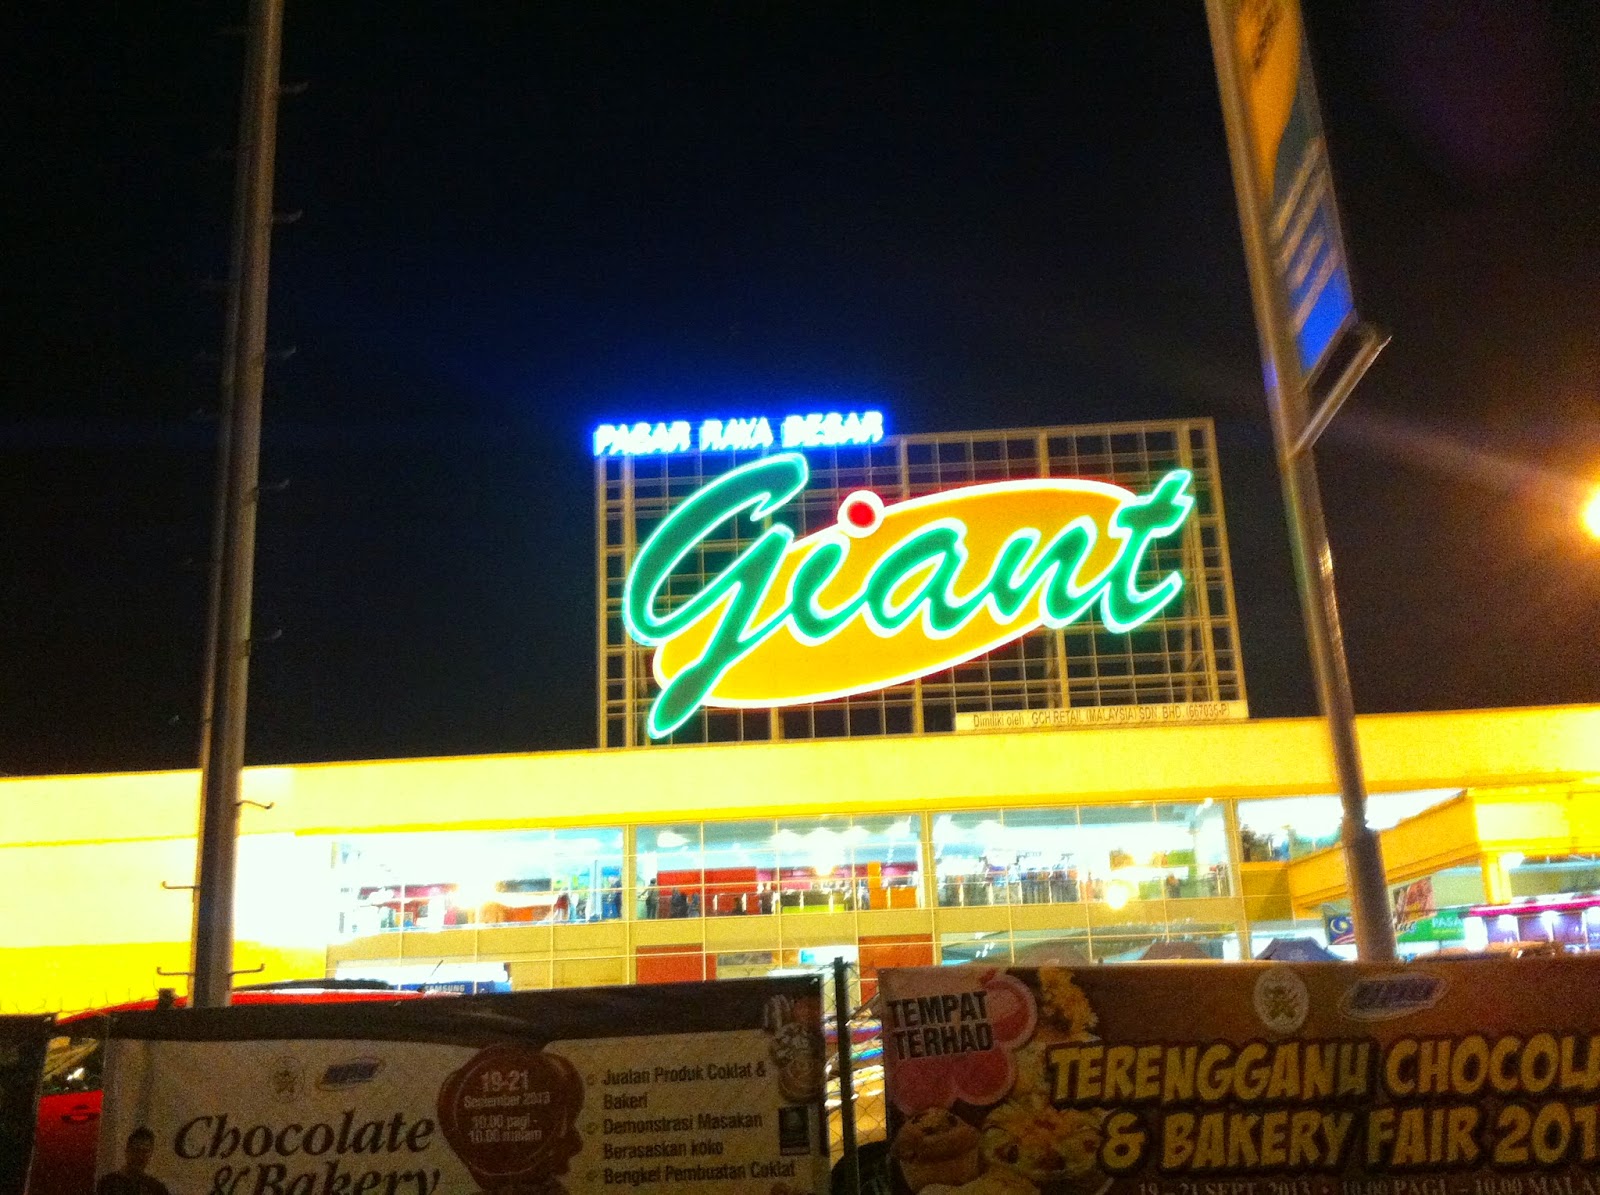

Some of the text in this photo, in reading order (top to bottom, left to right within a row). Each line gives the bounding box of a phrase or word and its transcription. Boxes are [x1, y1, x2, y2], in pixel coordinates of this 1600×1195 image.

[594, 411, 883, 455] PASAR RAYA BESAR
[973, 713, 1004, 727] Dimiliki
[1031, 711, 1051, 725] GCH
[1053, 709, 1085, 724] RETAIL
[1086, 707, 1137, 722] (MALAYSIA)
[424, 984, 466, 993] SAMSUNG
[886, 990, 988, 1028] TEMPAT
[891, 1022, 994, 1060] TERHAD
[480, 1069, 529, 1092] 19-21
[602, 1061, 767, 1086] Jualan Produk Coklat &
[1050, 1041, 1370, 1101] TERENGGANU
[463, 1093, 522, 1109] September
[603, 1093, 648, 1110] Bakeri
[173, 1108, 435, 1159] Chocolate
[602, 1112, 764, 1135] Demonstrasi Masakan
[1103, 1111, 1146, 1170] &
[1160, 1109, 1354, 1169] BAKERY
[1367, 1105, 1481, 1166] FAIR
[603, 1141, 688, 1160] Berasaskan
[253, 1159, 441, 1195] Bakery
[603, 1166, 661, 1187] Bengkel
[664, 1162, 747, 1183] Pembuatan
